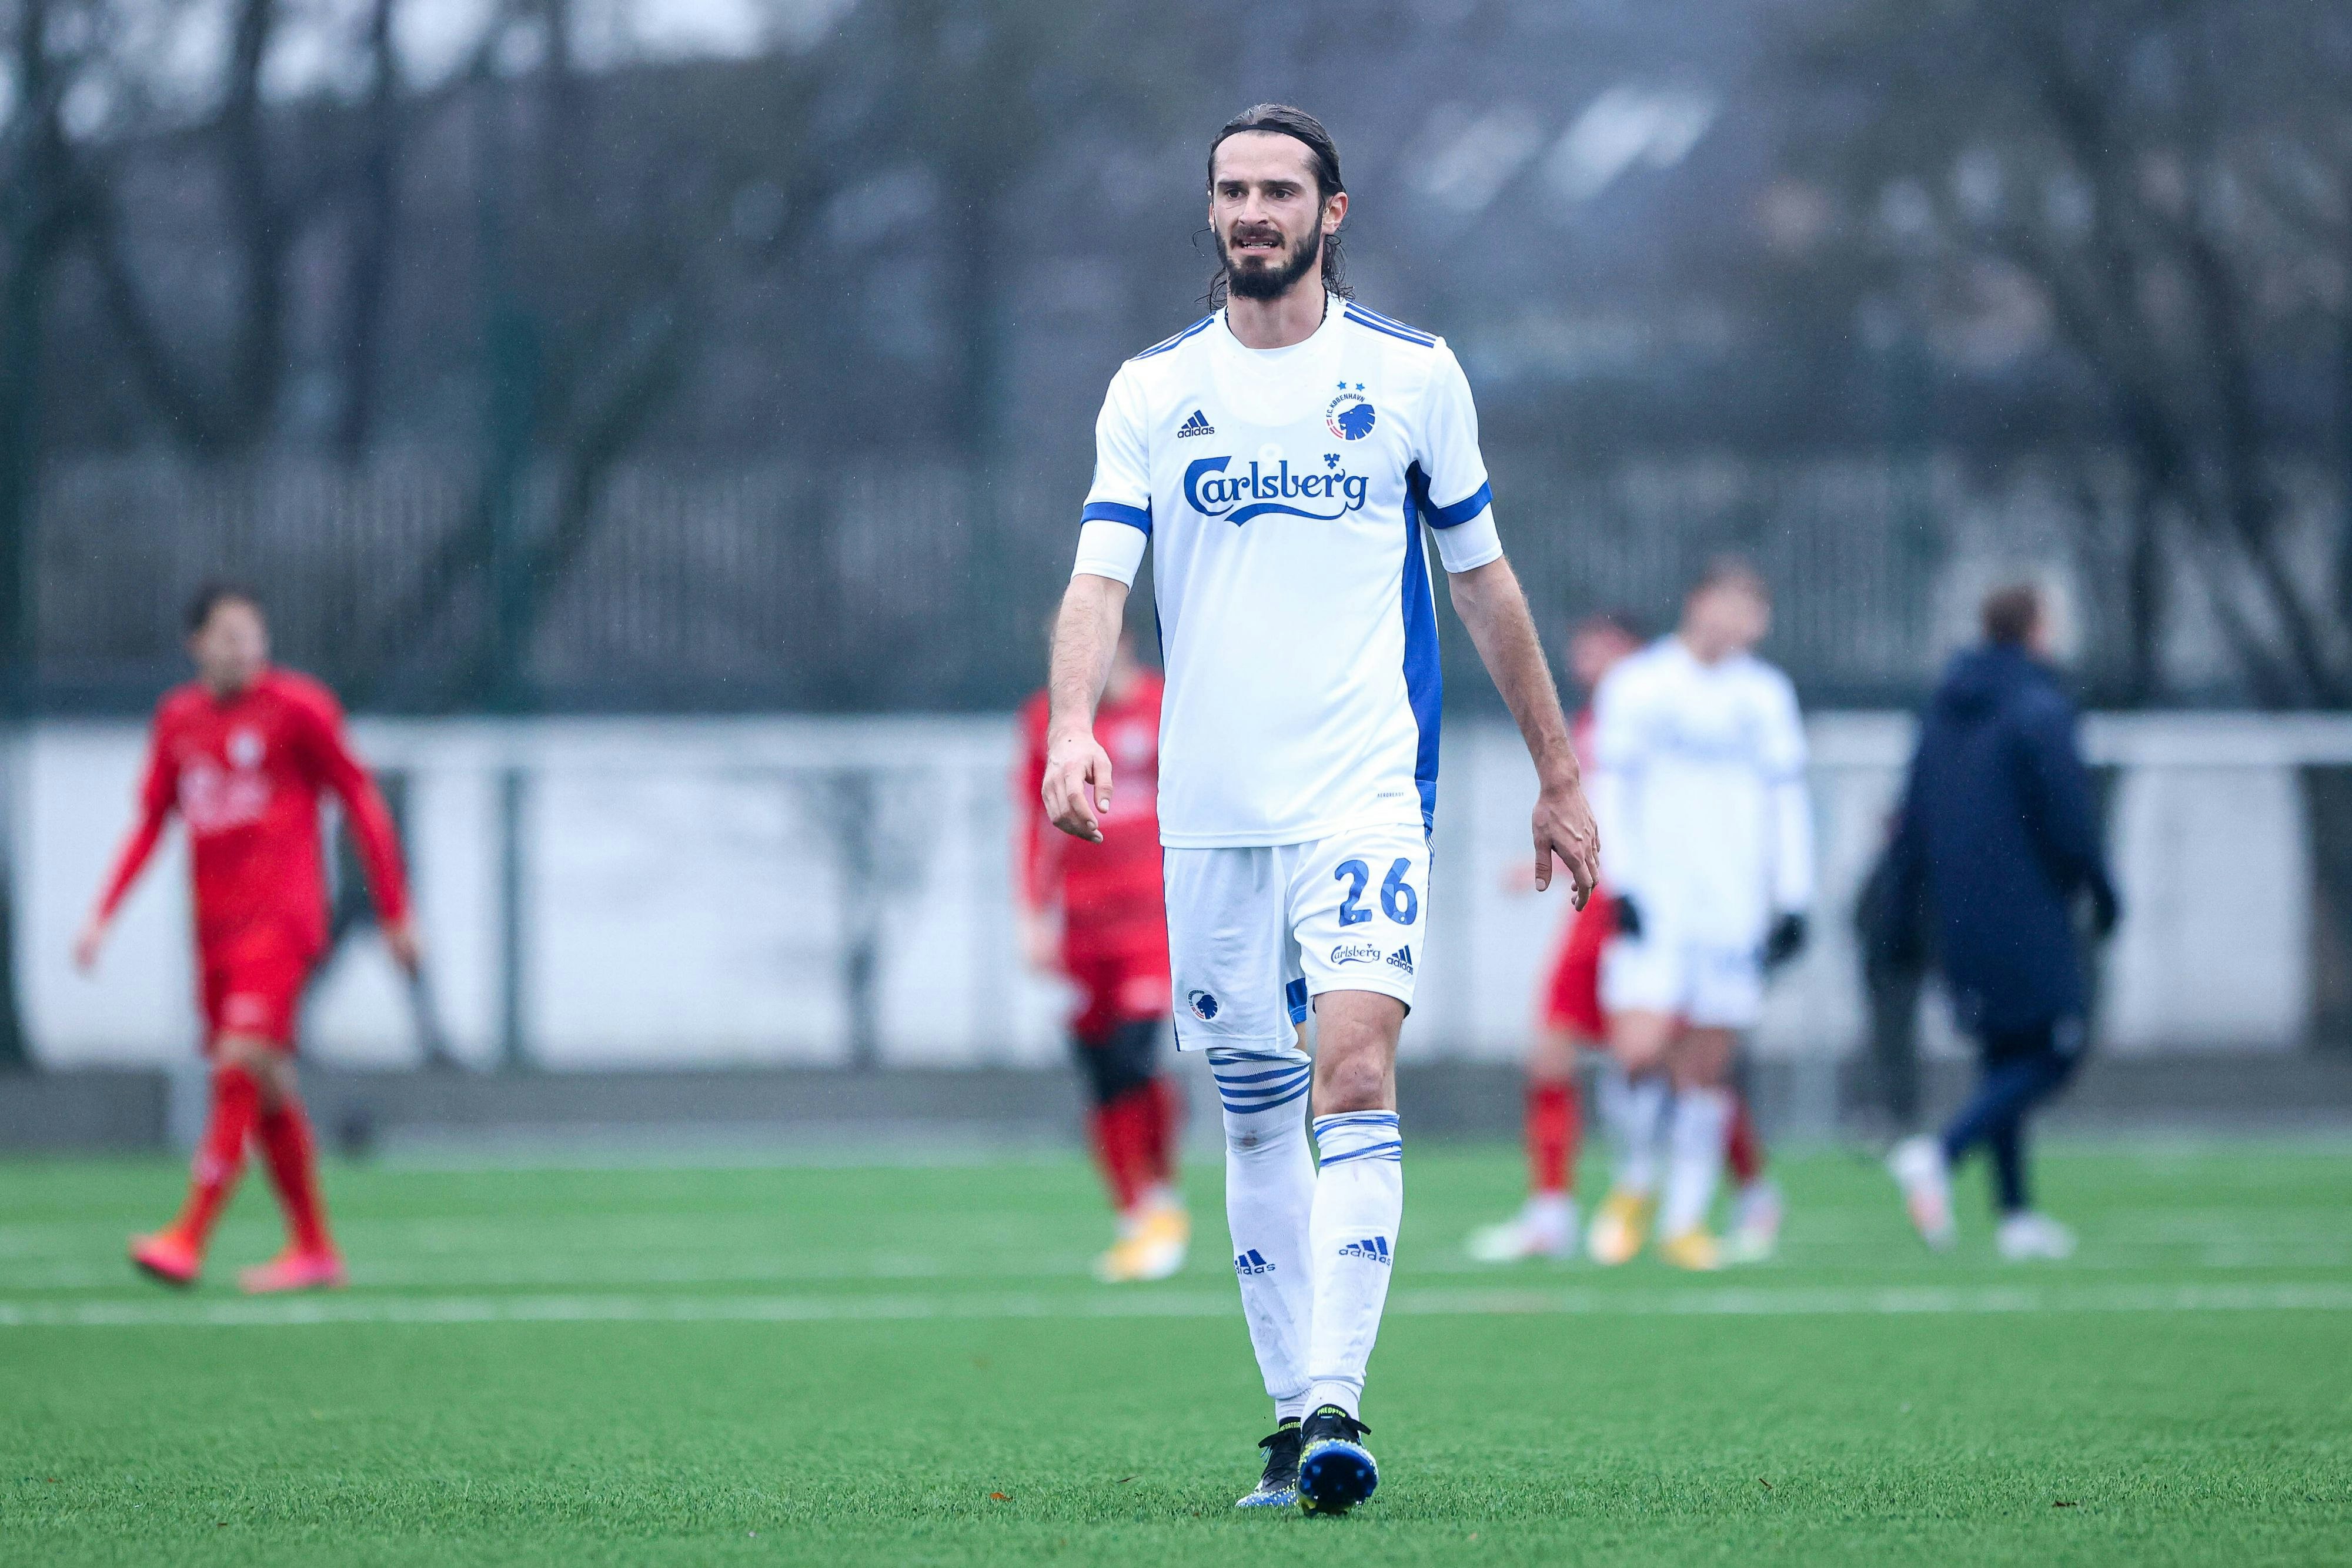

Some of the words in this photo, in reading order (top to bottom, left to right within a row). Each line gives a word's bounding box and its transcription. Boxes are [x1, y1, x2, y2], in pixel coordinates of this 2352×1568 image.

[1329, 393, 1365, 409] KØBENHAVN
[1177, 426, 1215, 438] adidas
[1184, 455, 1369, 525] Carlsberg
[1335, 858, 1418, 927] 26
[1331, 945, 1381, 965] Carlsberg
[1387, 957, 1414, 975] adidas
[1339, 1248, 1391, 1266] adidas
[1235, 1263, 1275, 1275] didas
